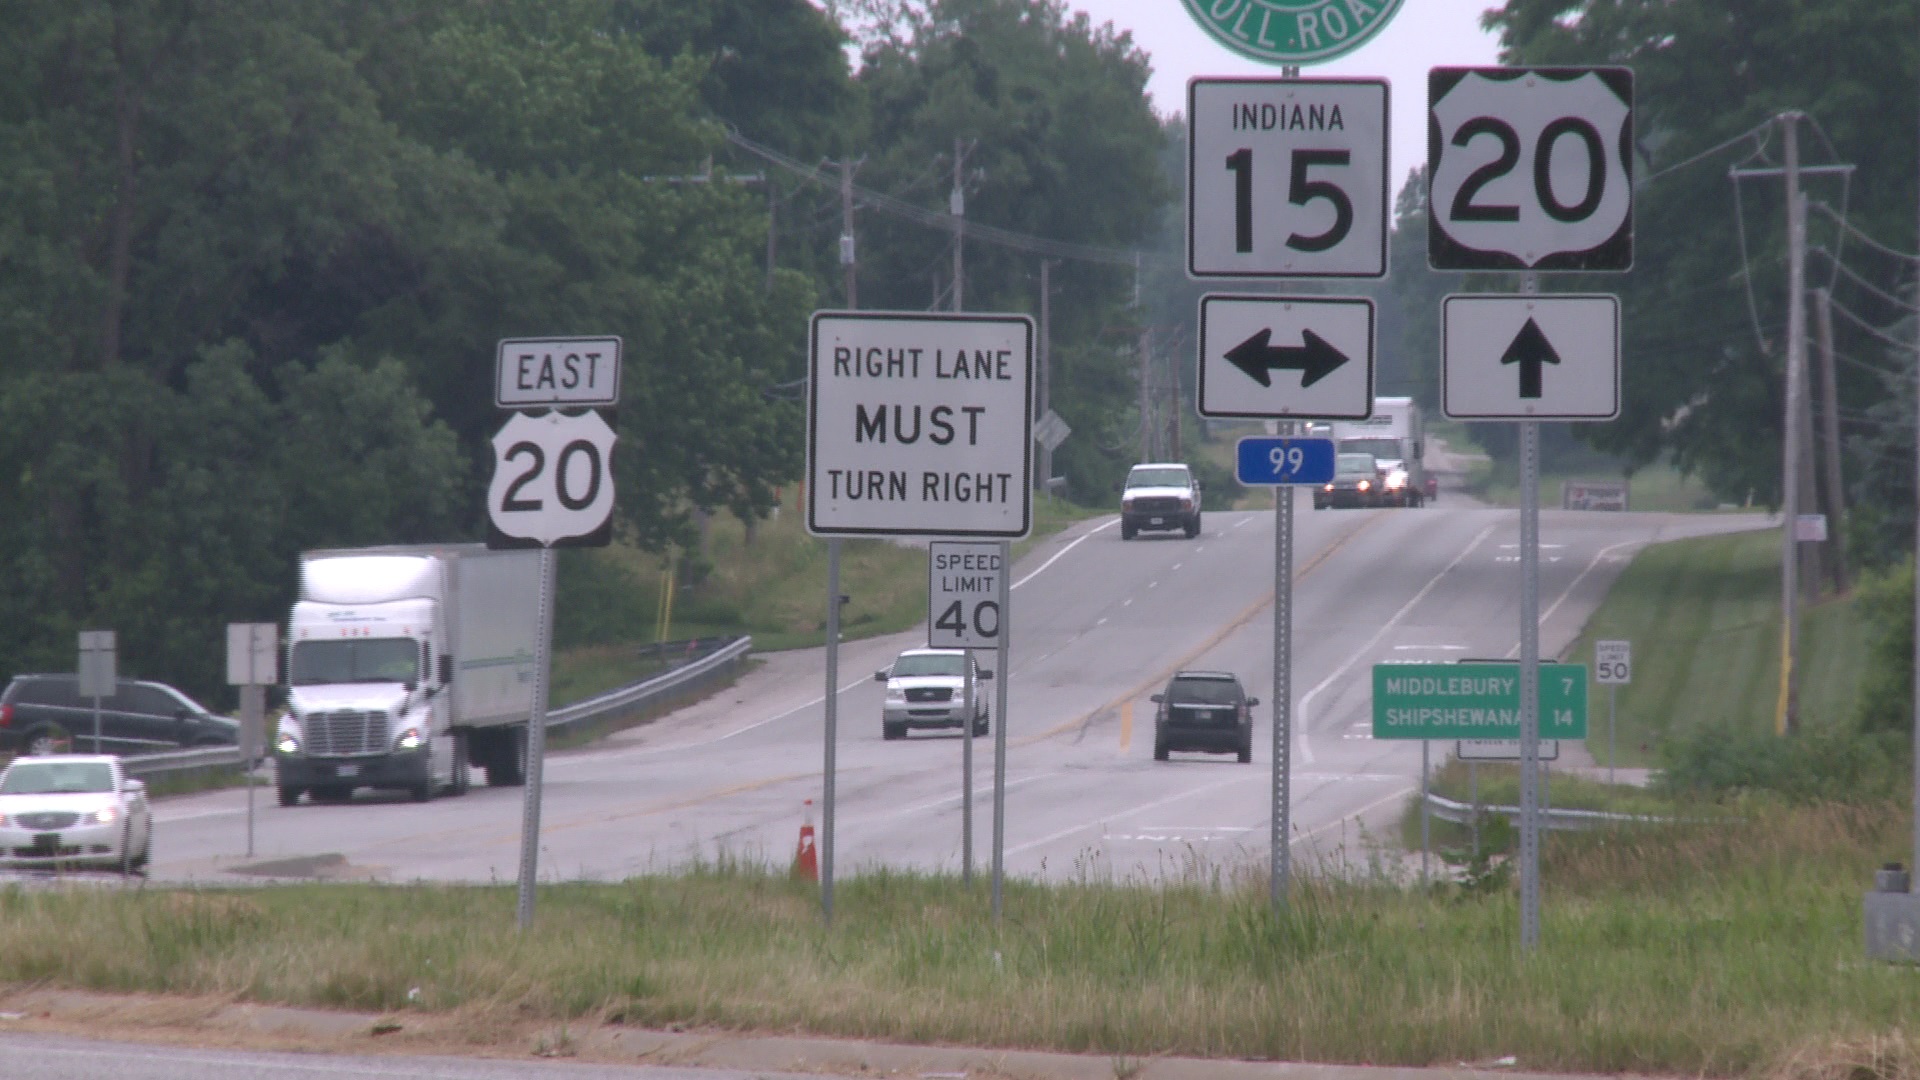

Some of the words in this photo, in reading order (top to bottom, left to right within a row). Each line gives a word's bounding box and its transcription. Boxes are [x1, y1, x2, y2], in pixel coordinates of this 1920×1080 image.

[1210, 0, 1276, 48] OLL
[1296, 0, 1391, 49] ROA
[1232, 103, 1345, 131] INDIANA
[1449, 116, 1608, 223] 20
[1225, 148, 1354, 254] 15
[516, 352, 602, 391] EAST
[833, 347, 923, 378] RIGHT
[936, 349, 1012, 380] LANE
[854, 404, 986, 446] MUST
[500, 438, 601, 512] 20
[1268, 446, 1304, 475] 99
[827, 469, 907, 501] TURN
[921, 471, 1012, 503] RIGHT
[936, 554, 1000, 571] SPEED
[942, 576, 994, 592] LIMIT
[935, 599, 999, 638] 40
[1386, 678, 1514, 696] MIDDLEBURY
[1561, 678, 1573, 696] 7
[1599, 662, 1627, 680] 50
[1553, 710, 1573, 727] 14
